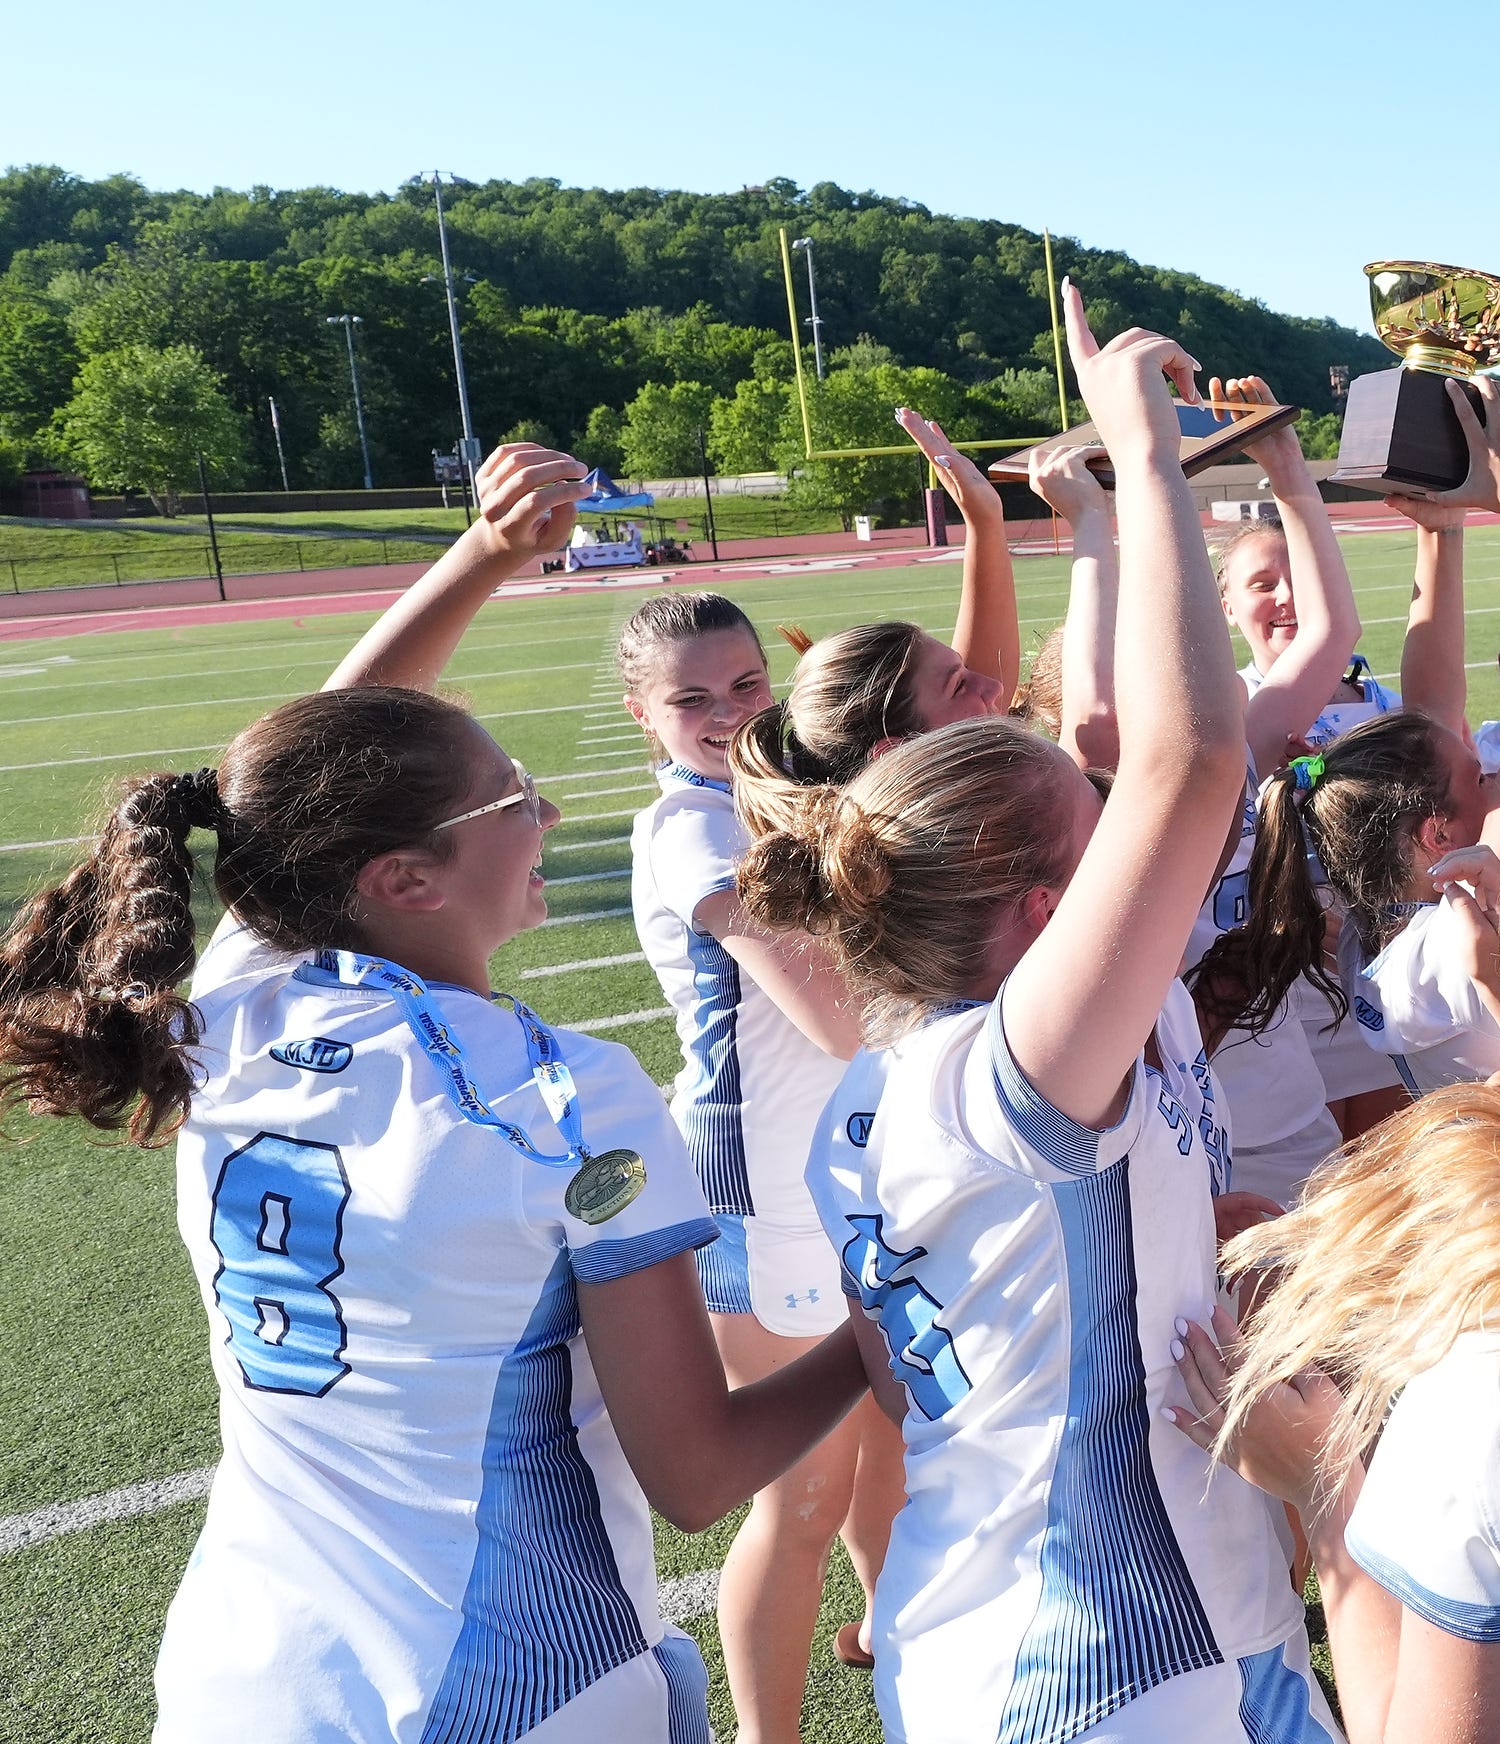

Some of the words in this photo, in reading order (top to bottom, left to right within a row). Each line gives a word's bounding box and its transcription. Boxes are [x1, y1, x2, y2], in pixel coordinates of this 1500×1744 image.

[418, 1012, 450, 1053] NYSPHSAA
[1356, 1001, 1382, 1028] MJD
[284, 1041, 339, 1067] MJD
[451, 1068, 480, 1111] NYSPHSAA
[209, 1131, 352, 1398] 8
